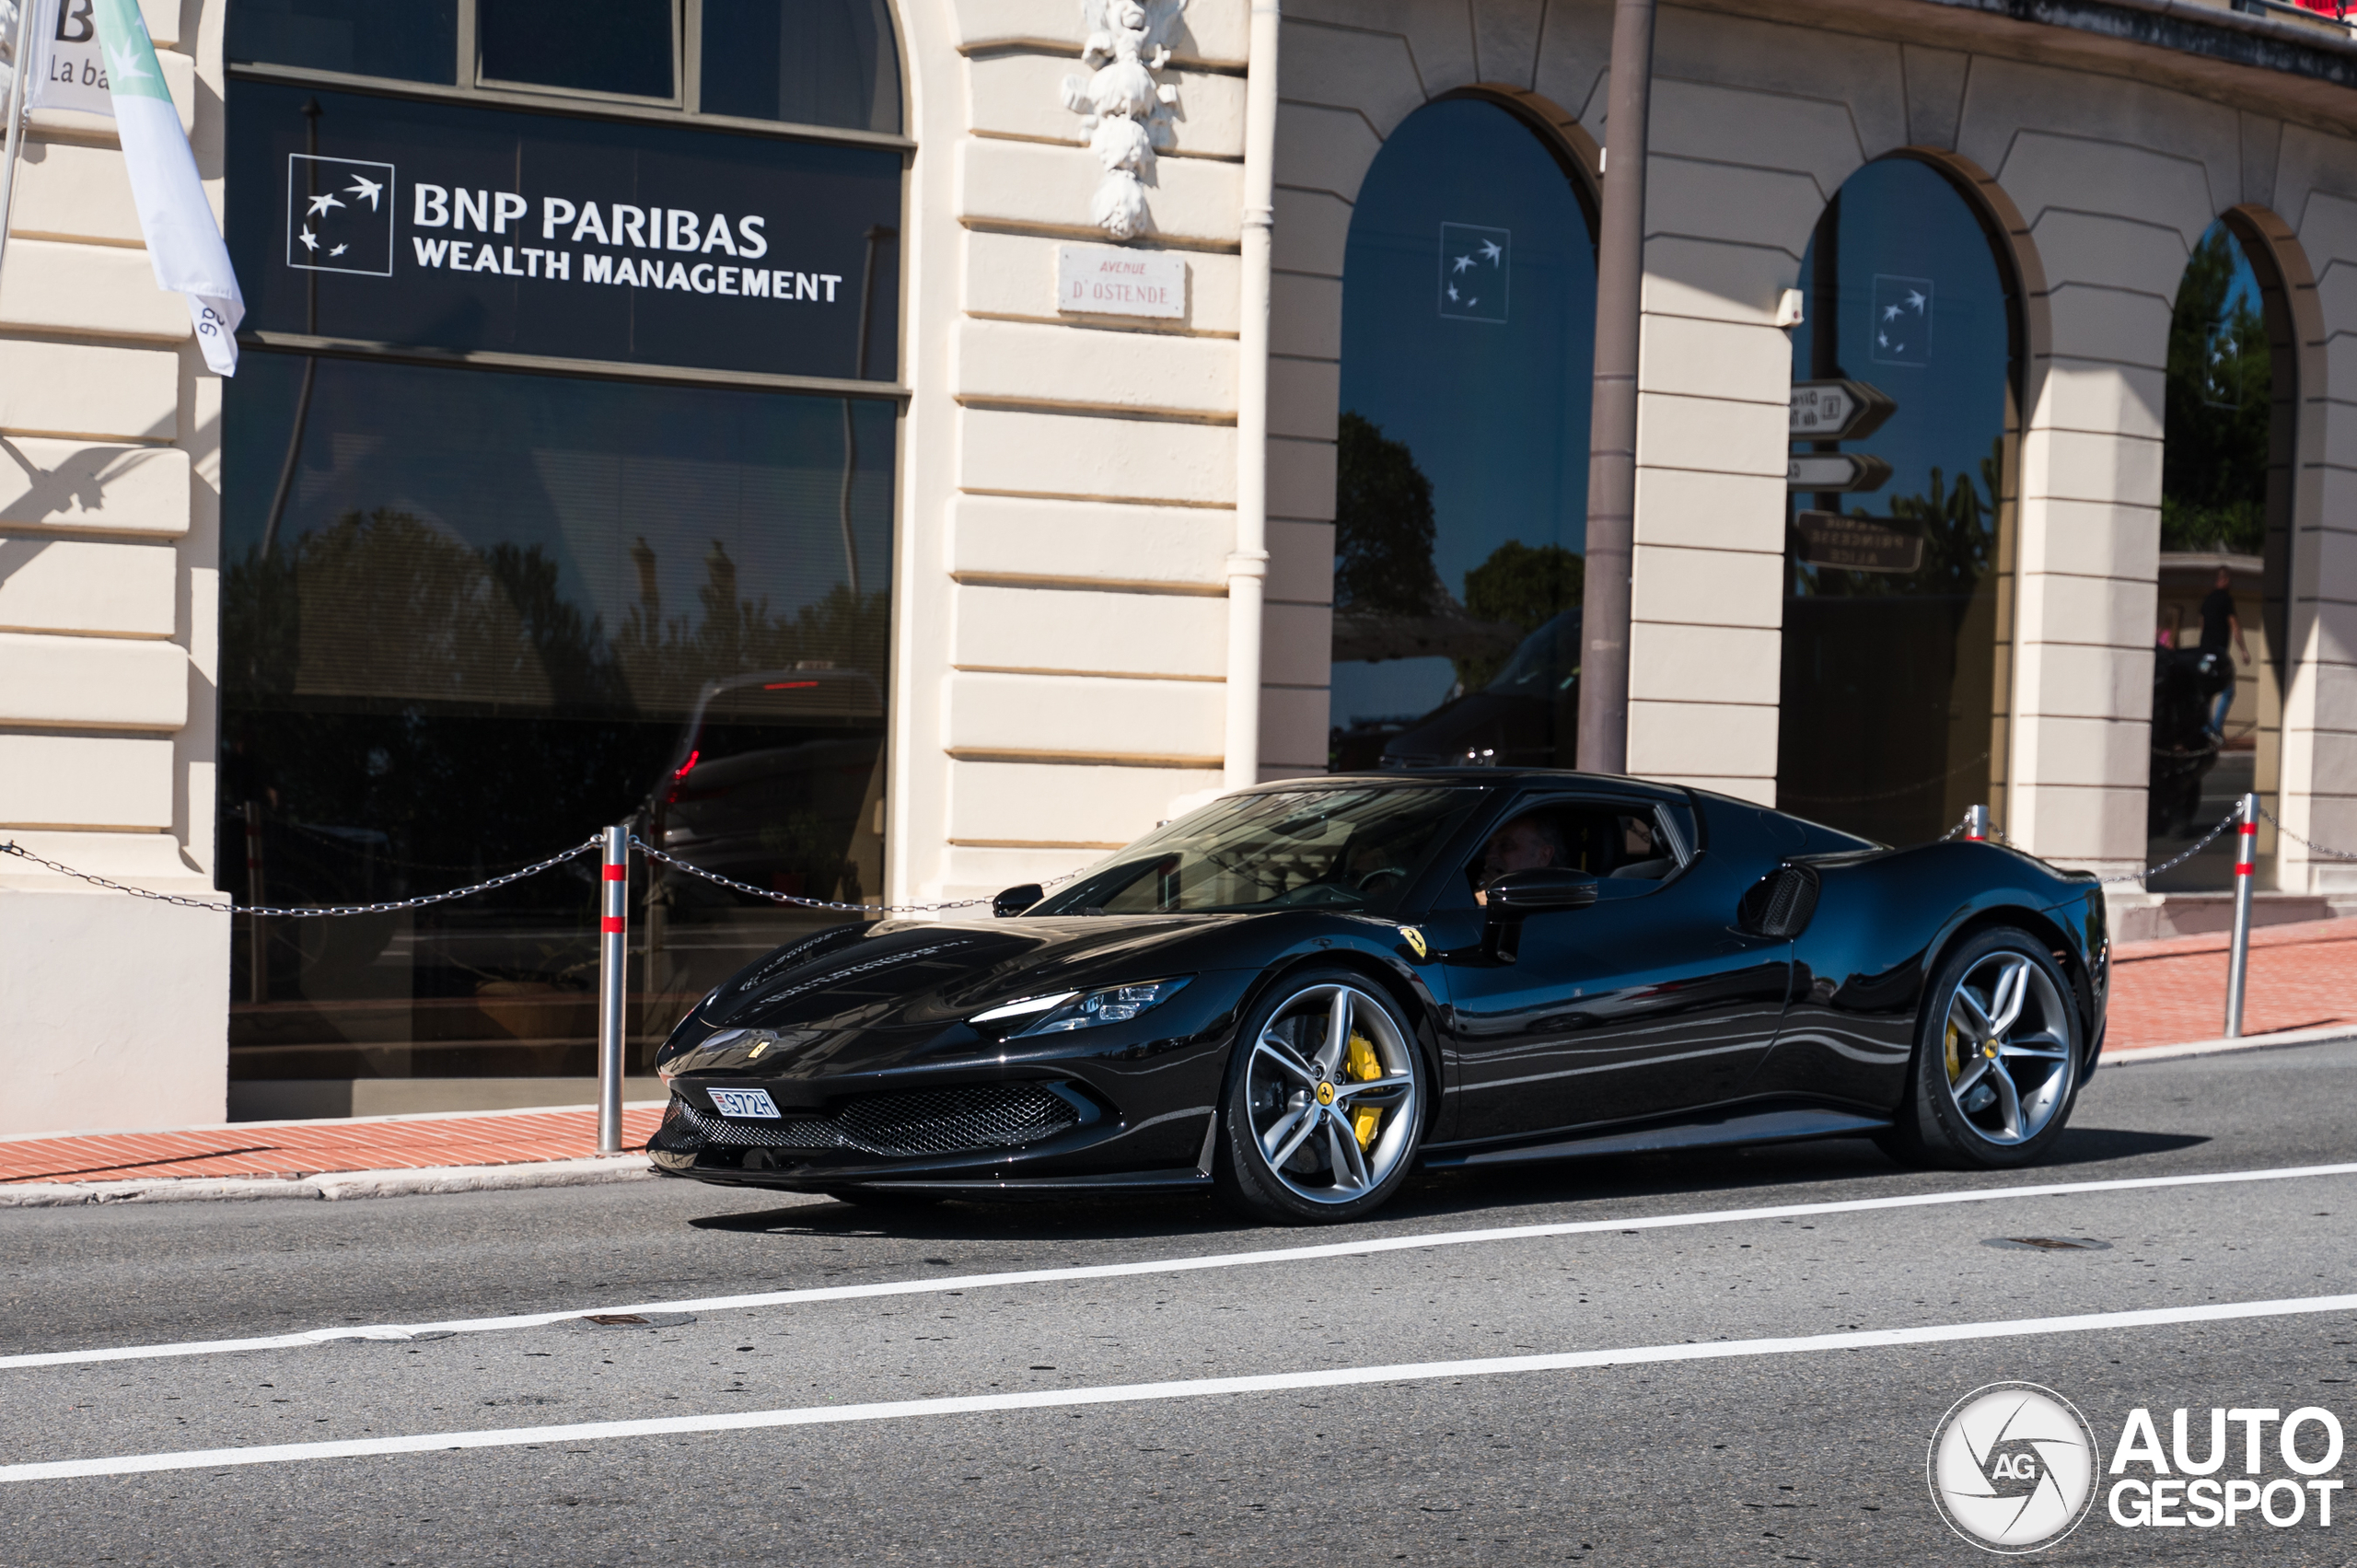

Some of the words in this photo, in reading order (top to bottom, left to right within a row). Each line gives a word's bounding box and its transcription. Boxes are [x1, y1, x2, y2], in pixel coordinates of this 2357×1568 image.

[51, 53, 74, 83] La
[412, 181, 528, 236] BNP
[542, 196, 768, 259] PARIBAS
[412, 236, 570, 281] WEALTH
[582, 254, 842, 303] MANAGEMENT
[1099, 261, 1147, 275] AVENUE
[725, 1093, 777, 1115] 972H
